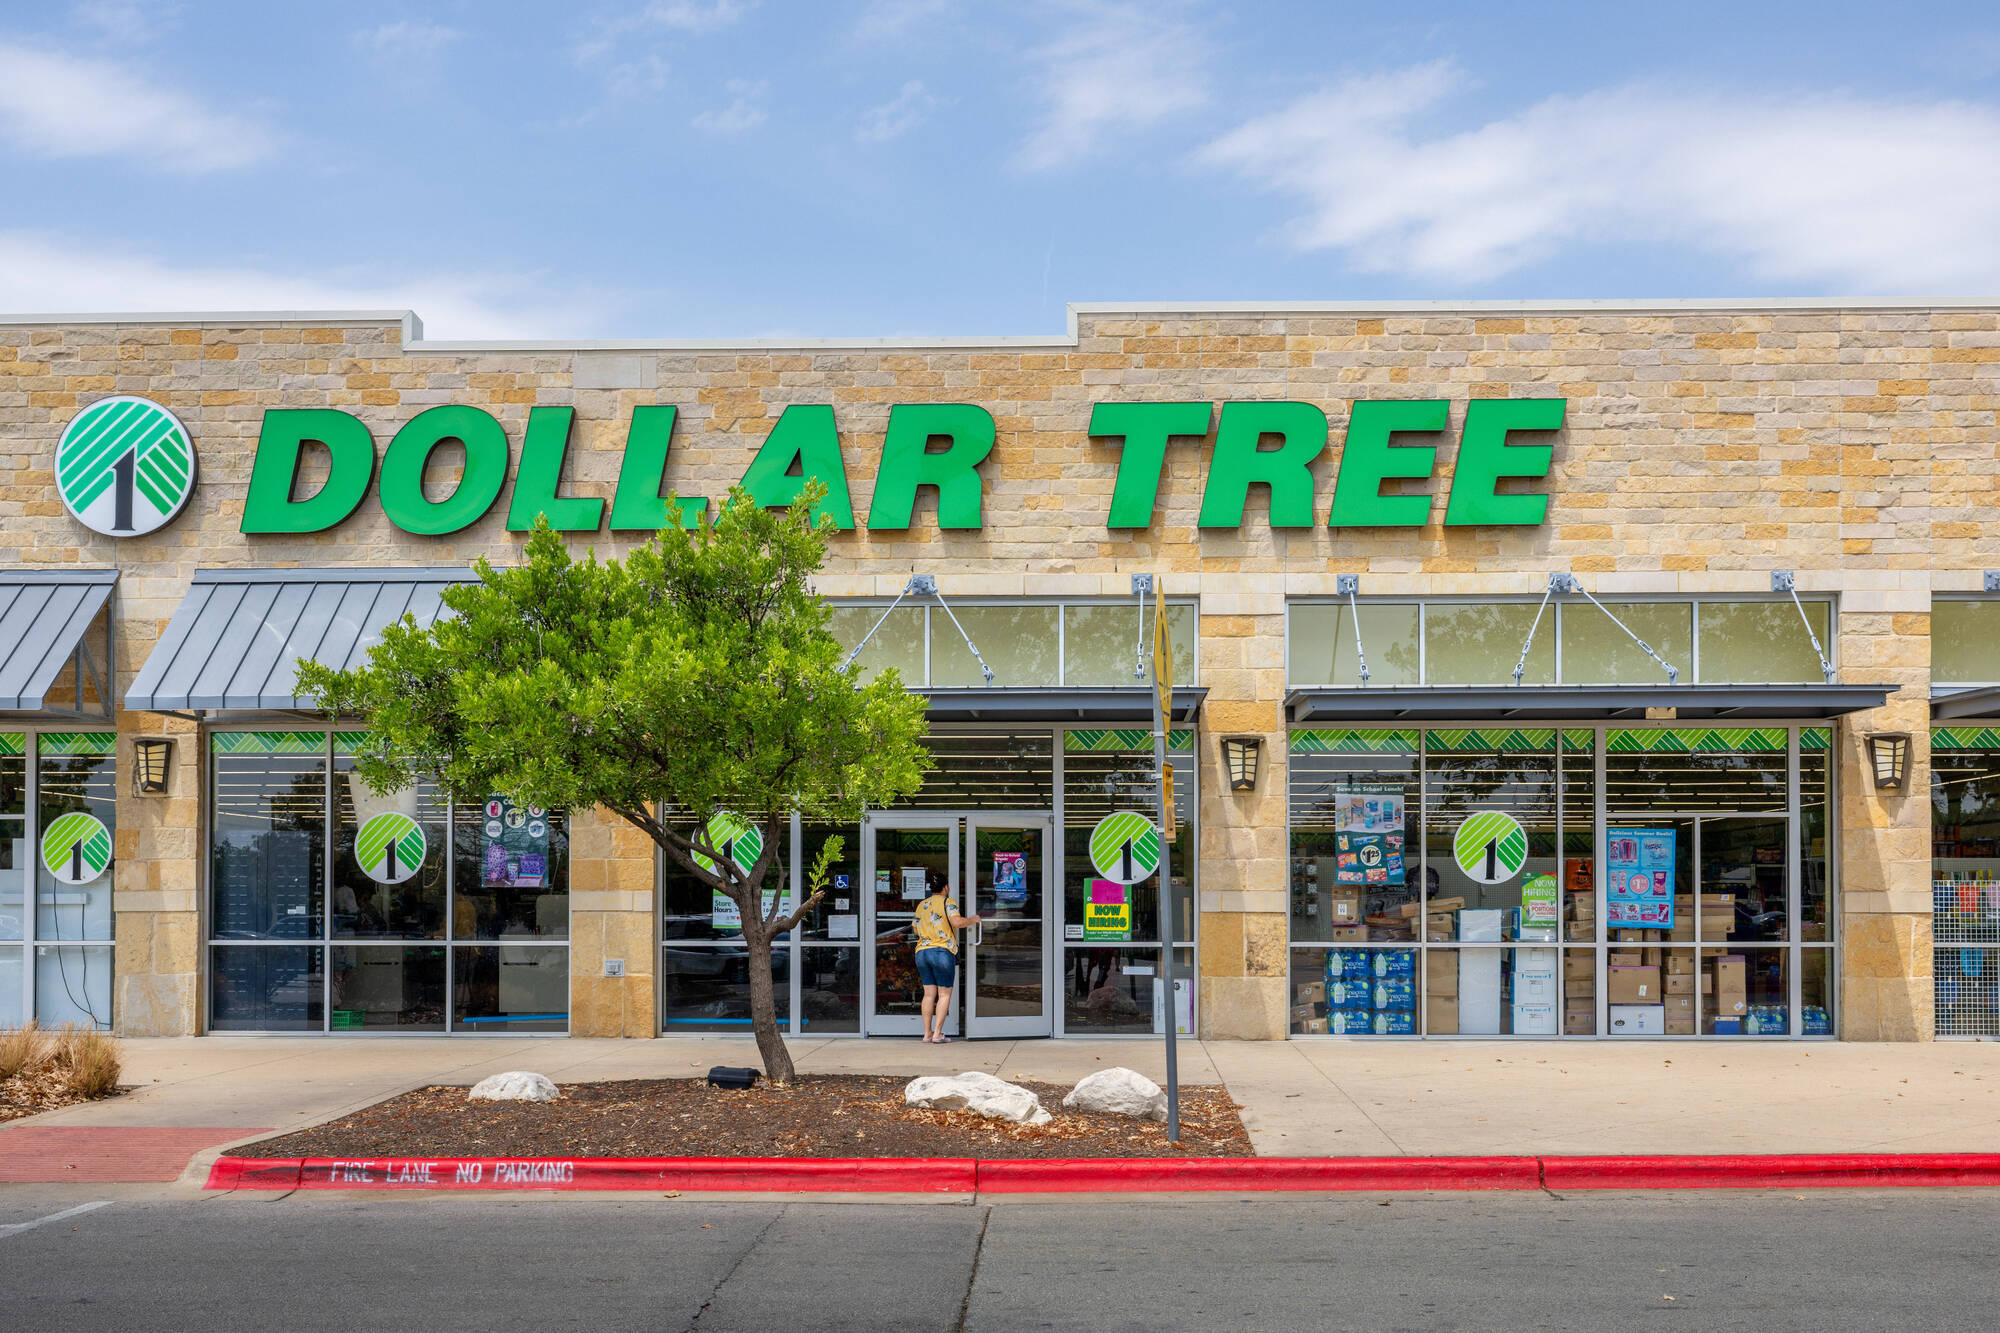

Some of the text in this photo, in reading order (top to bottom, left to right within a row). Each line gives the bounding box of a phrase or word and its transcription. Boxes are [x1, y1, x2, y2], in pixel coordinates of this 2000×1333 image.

[239, 398, 1568, 535] DOLLAR TREE
[110, 446, 136, 531] 1
[70, 838, 83, 881] 1
[383, 837, 397, 881] 1
[1119, 837, 1133, 881] 1
[1484, 837, 1497, 881] 1
[1094, 905, 1121, 916] NOW
[1523, 888, 1556, 897] HIRING
[1088, 917, 1127, 928] HIRING
[329, 1161, 574, 1184] FIRE LANE NO PARKING
